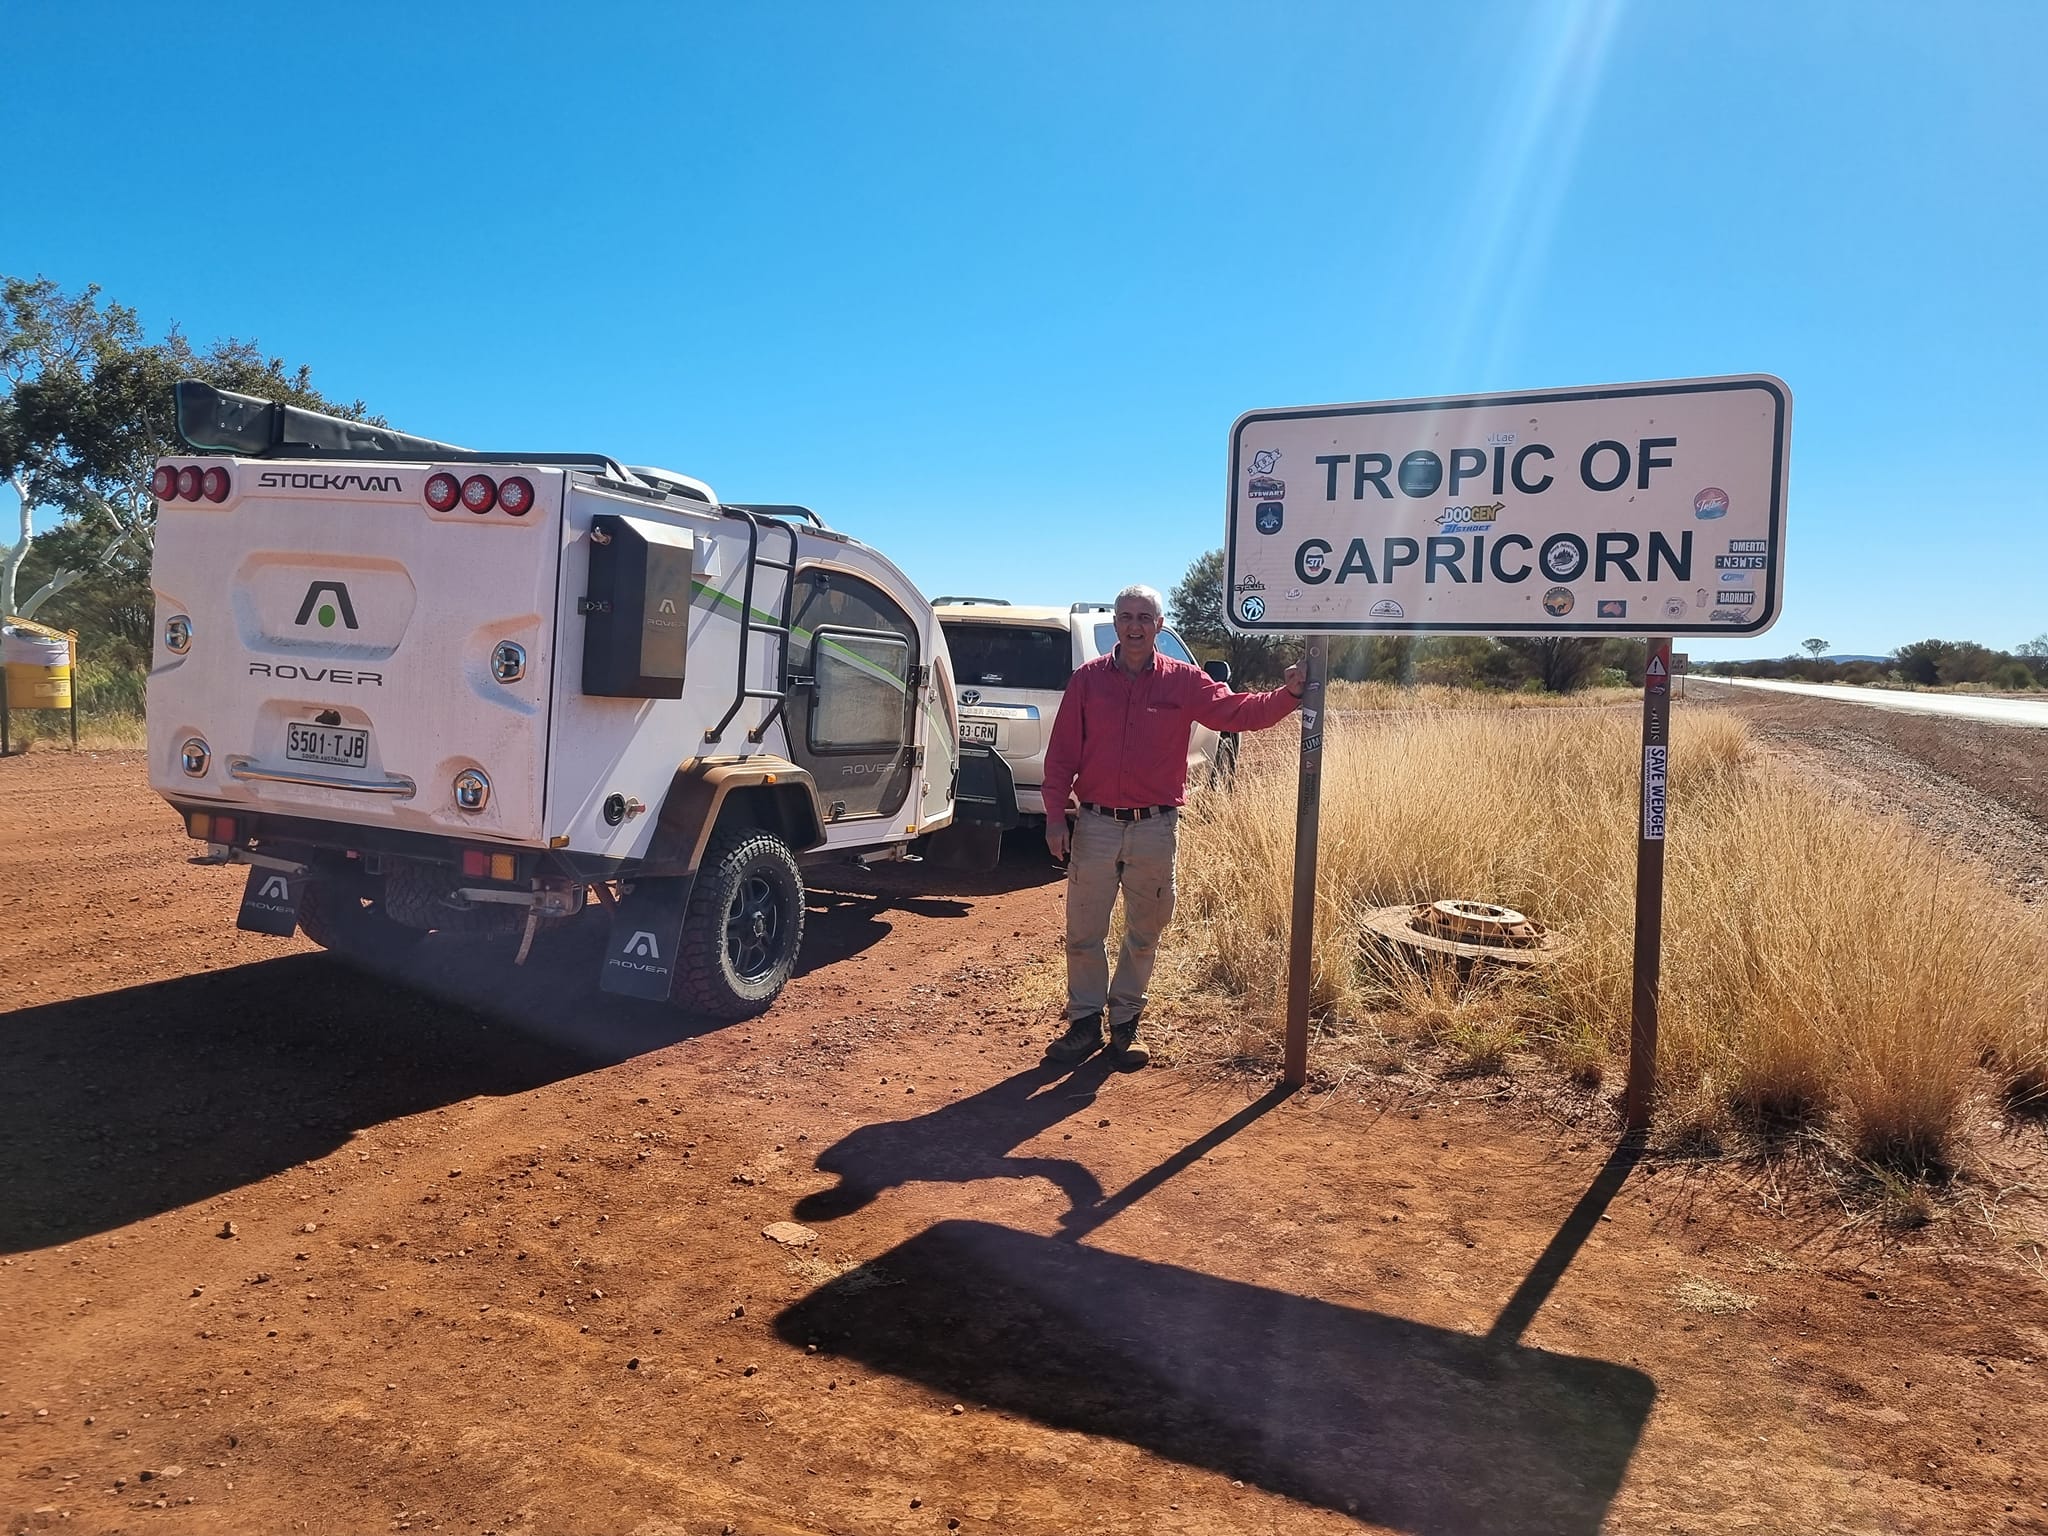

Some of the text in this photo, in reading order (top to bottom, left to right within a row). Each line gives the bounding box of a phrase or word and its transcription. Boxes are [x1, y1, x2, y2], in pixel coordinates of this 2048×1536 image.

[1315, 443, 1555, 501] TROPIC
[1579, 437, 1677, 491] OF
[257, 472, 402, 492] STOCKMAN
[1294, 530, 1693, 585] CAPRICORN
[1732, 541, 1765, 552] OMERTA
[249, 662, 383, 686] ROVER
[290, 730, 364, 758] S501-TJB
[842, 762, 897, 776] ROVER
[1651, 748, 1665, 780] SAVE
[1651, 785, 1664, 837] WEDGE!
[245, 901, 295, 914] ROVER
[609, 958, 668, 975] ROVER
